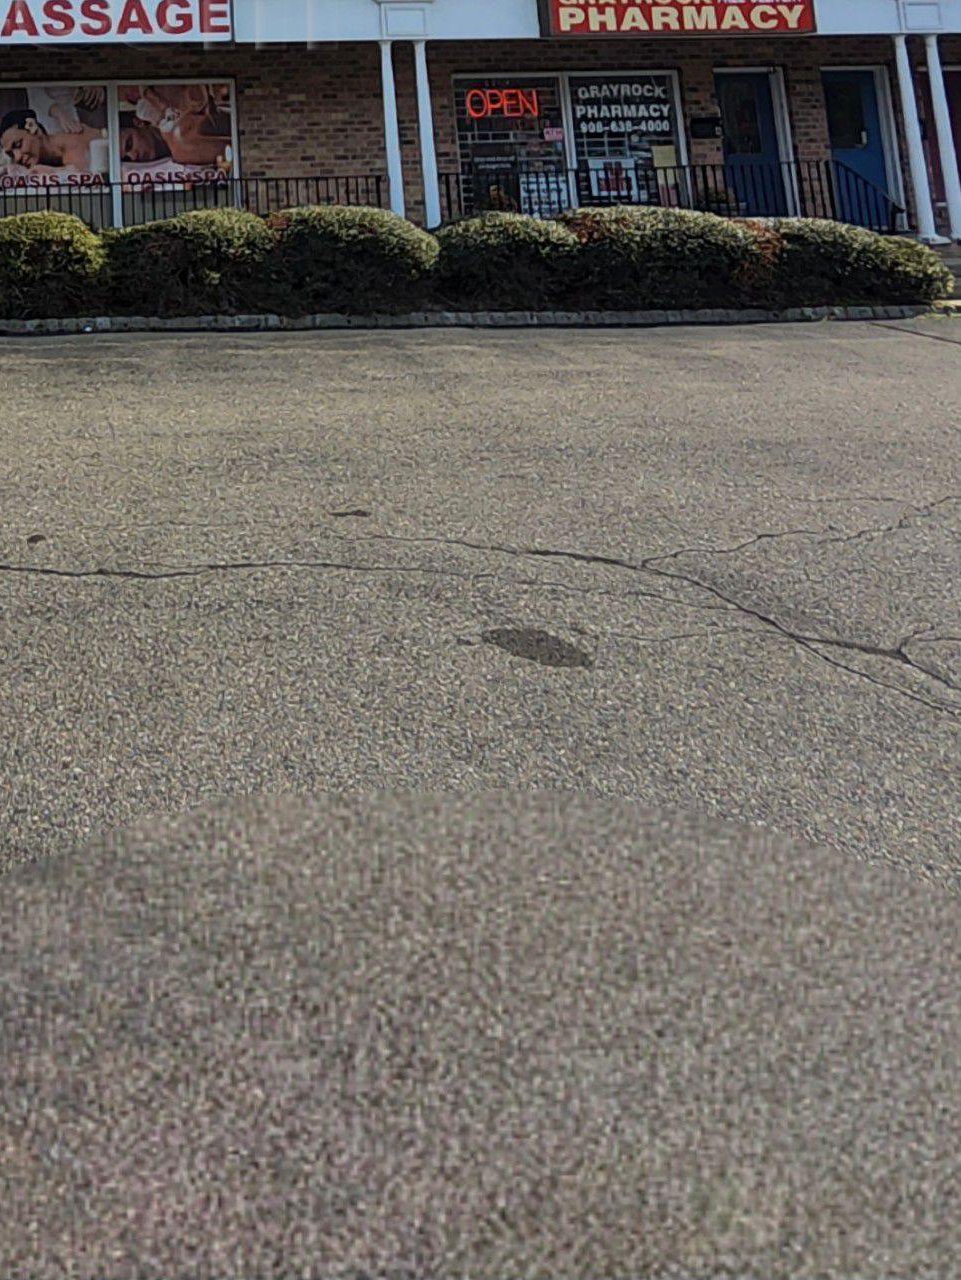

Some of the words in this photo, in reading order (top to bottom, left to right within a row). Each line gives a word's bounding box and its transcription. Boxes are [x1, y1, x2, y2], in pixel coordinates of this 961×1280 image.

[557, 4, 805, 32] PHARMACY
[577, 84, 667, 99] GRAYROCK
[465, 88, 540, 118] OPEN
[575, 104, 671, 119] PHARMACY
[0, 174, 61, 189] OASIS
[67, 173, 105, 187] SPA
[127, 171, 186, 186] OASIS
[191, 169, 229, 185] SPA
